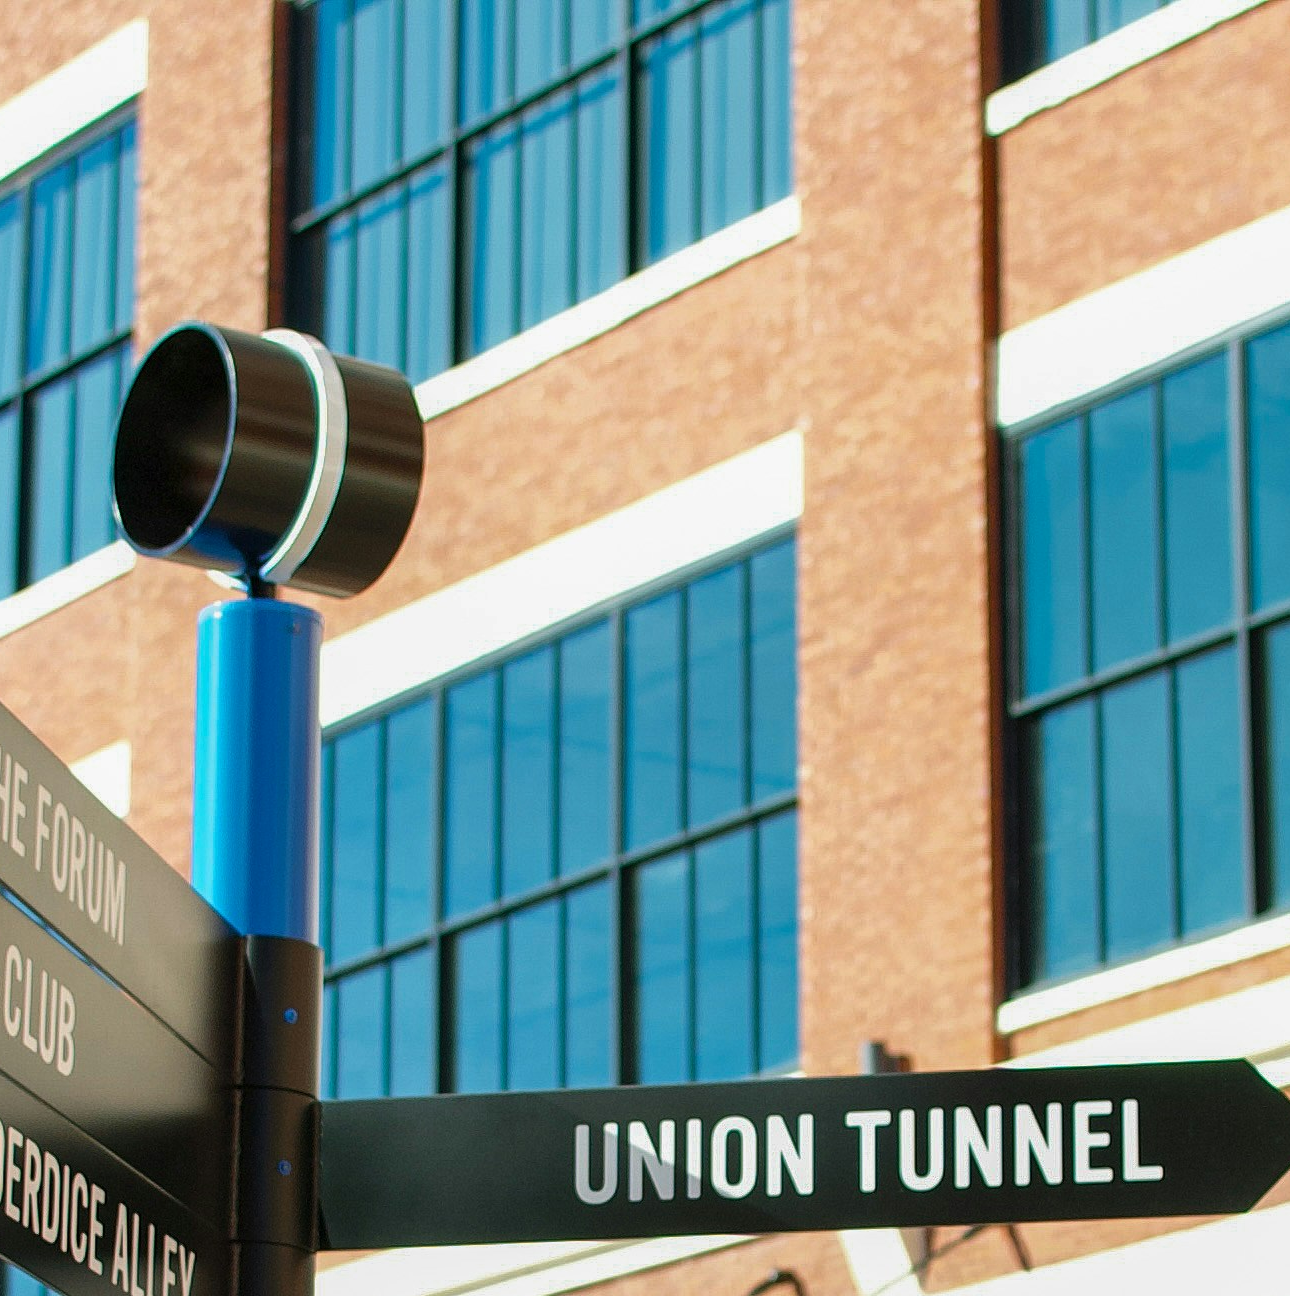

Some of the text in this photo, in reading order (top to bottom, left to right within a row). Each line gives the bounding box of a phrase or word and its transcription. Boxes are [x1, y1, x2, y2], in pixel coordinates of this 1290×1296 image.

[33, 786, 127, 946] FORUM
[4, 945, 76, 1076] CLUB
[575, 1099, 1164, 1205] UNION TUNNEL
